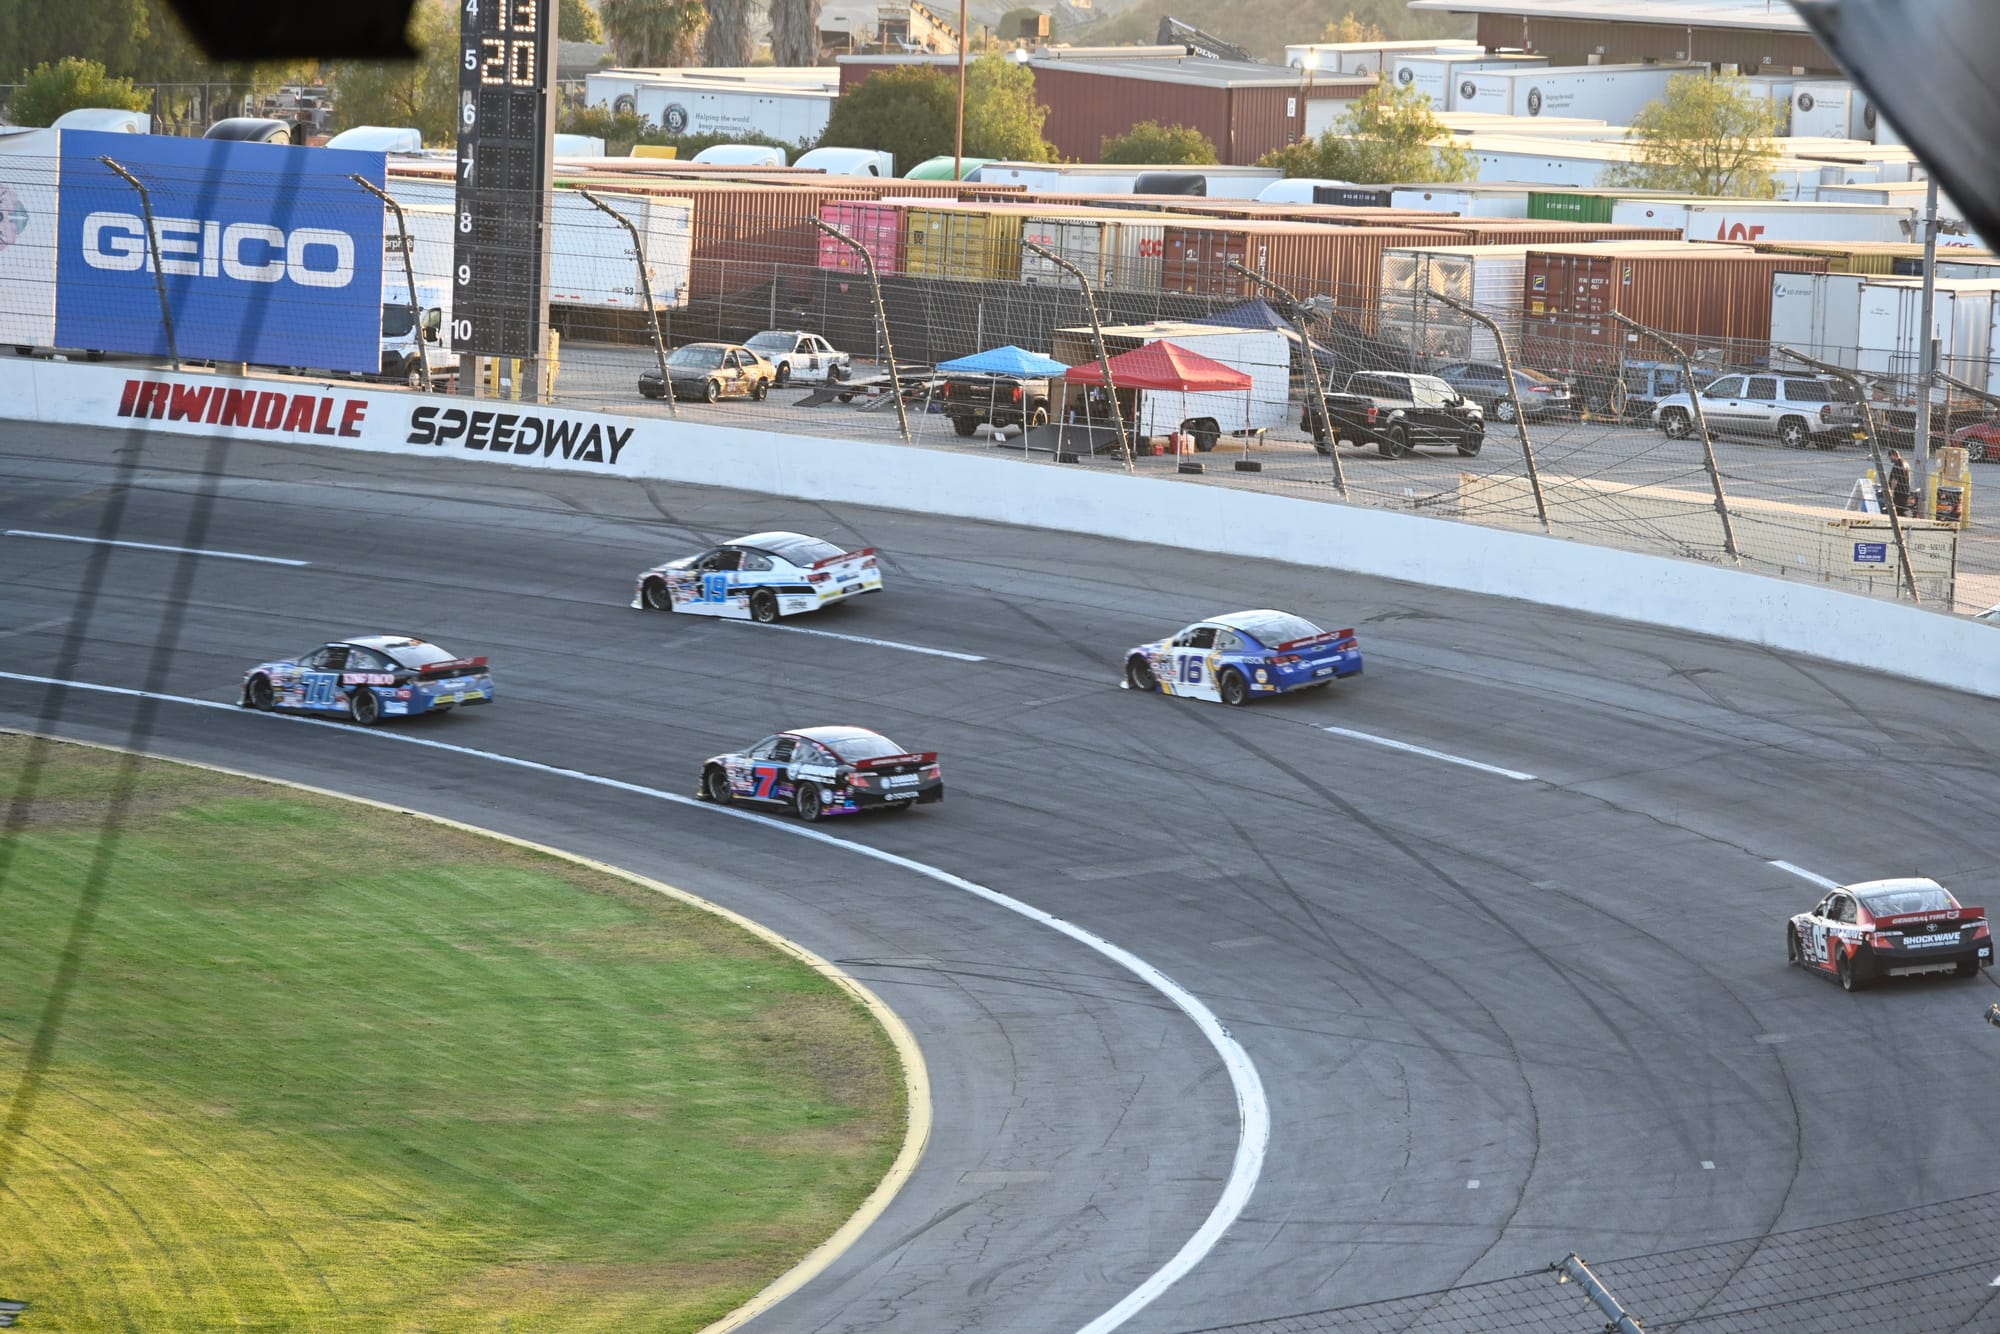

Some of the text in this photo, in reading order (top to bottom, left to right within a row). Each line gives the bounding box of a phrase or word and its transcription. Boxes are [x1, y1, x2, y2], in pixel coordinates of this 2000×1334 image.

[465, 0, 479, 16] 4
[464, 49, 477, 70] 5
[481, 38, 535, 86] 20
[463, 104, 476, 124] 6
[461, 158, 474, 179] 7
[459, 213, 472, 233] 8
[82, 211, 355, 288] GEICO
[458, 265, 471, 285] 9
[451, 320, 472, 340] 10
[117, 379, 635, 465] IRWINDALE SPEEDWAY
[704, 574, 727, 603] 19
[1178, 655, 1204, 683] 16
[754, 766, 777, 798] 7
[1903, 931, 1961, 945] SHOCKWAVE
